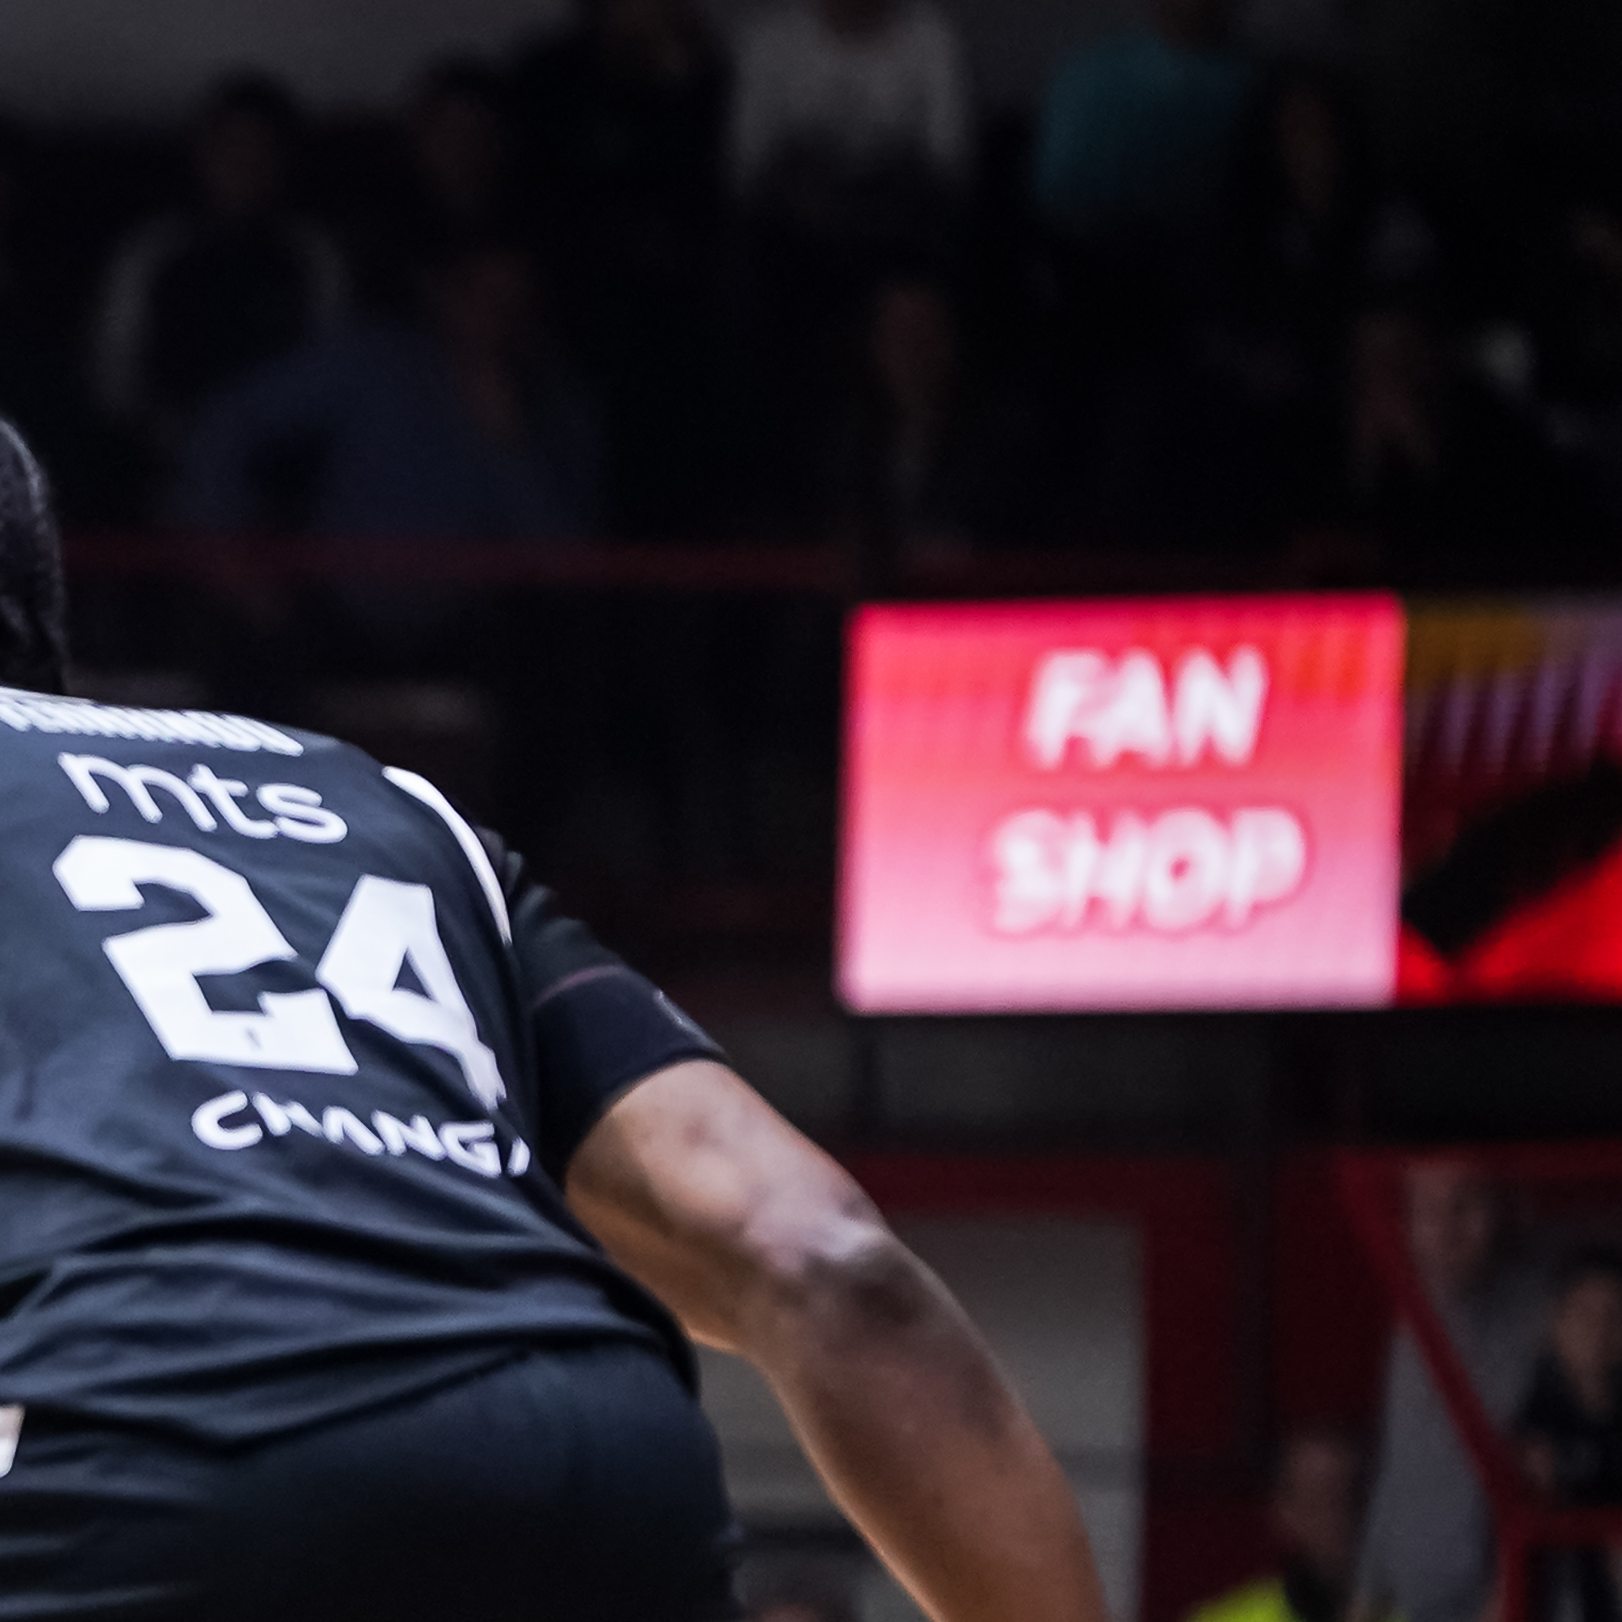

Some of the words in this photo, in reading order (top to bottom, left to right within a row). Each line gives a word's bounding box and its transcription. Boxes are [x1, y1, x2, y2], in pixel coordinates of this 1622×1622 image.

[1024, 646, 1268, 768] FAN
[57, 752, 348, 843] mts
[986, 808, 1306, 930] SHOP
[52, 834, 507, 1113] 24
